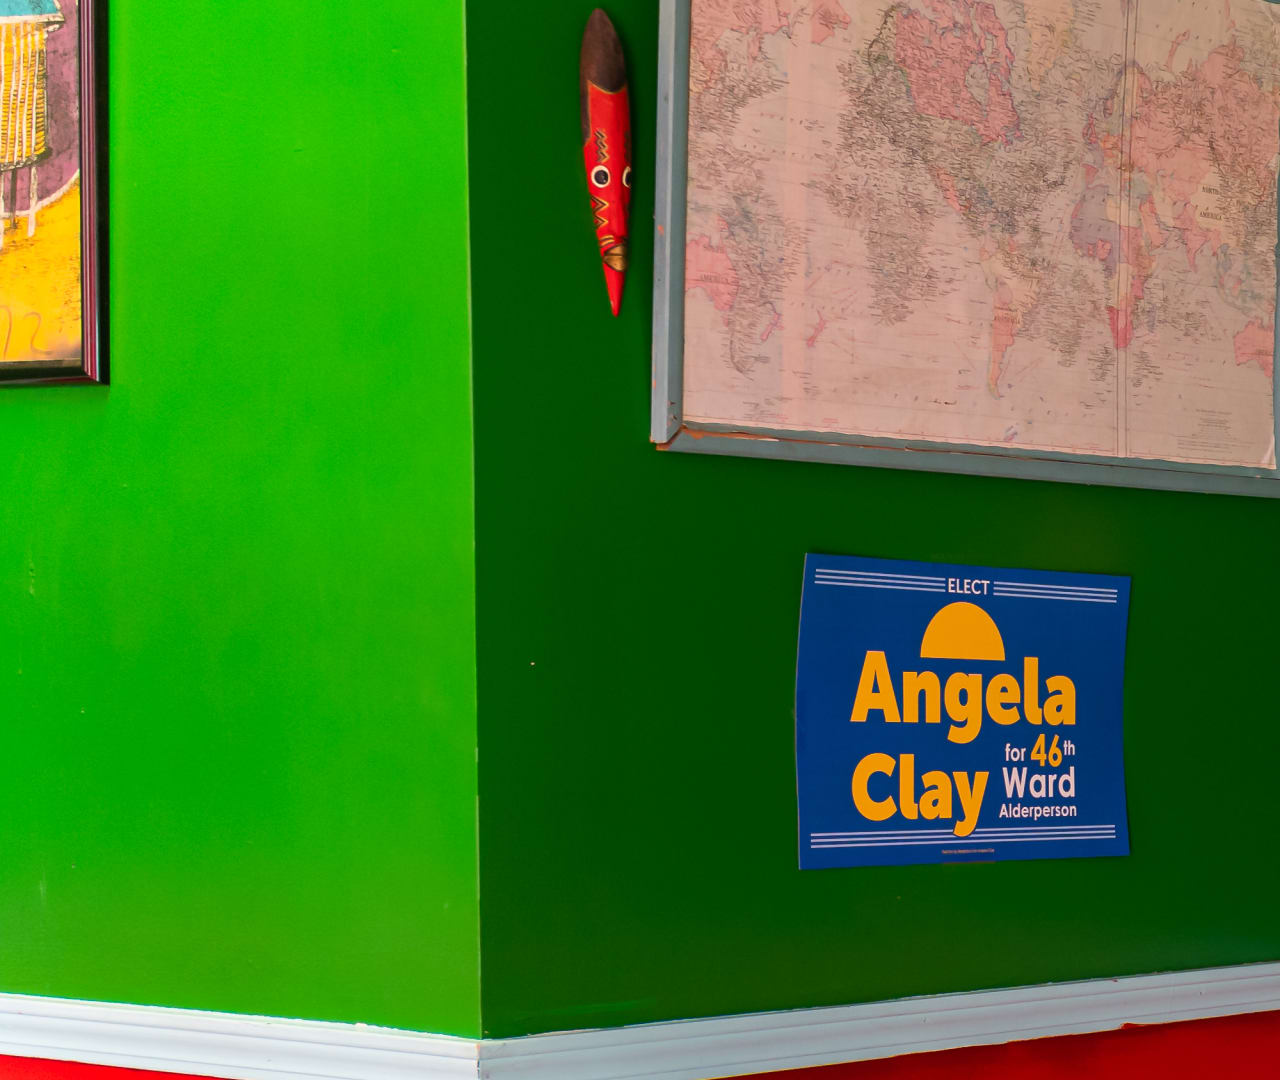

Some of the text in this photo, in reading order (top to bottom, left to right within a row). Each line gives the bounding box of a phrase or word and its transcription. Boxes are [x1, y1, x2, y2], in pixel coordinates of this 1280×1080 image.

[948, 578, 990, 595] ELECT
[850, 650, 1076, 744] Angela
[1005, 733, 1075, 767] for 46th
[851, 752, 989, 837] Clay
[1003, 766, 1075, 798] Ward
[999, 802, 1077, 820] Alderperson
